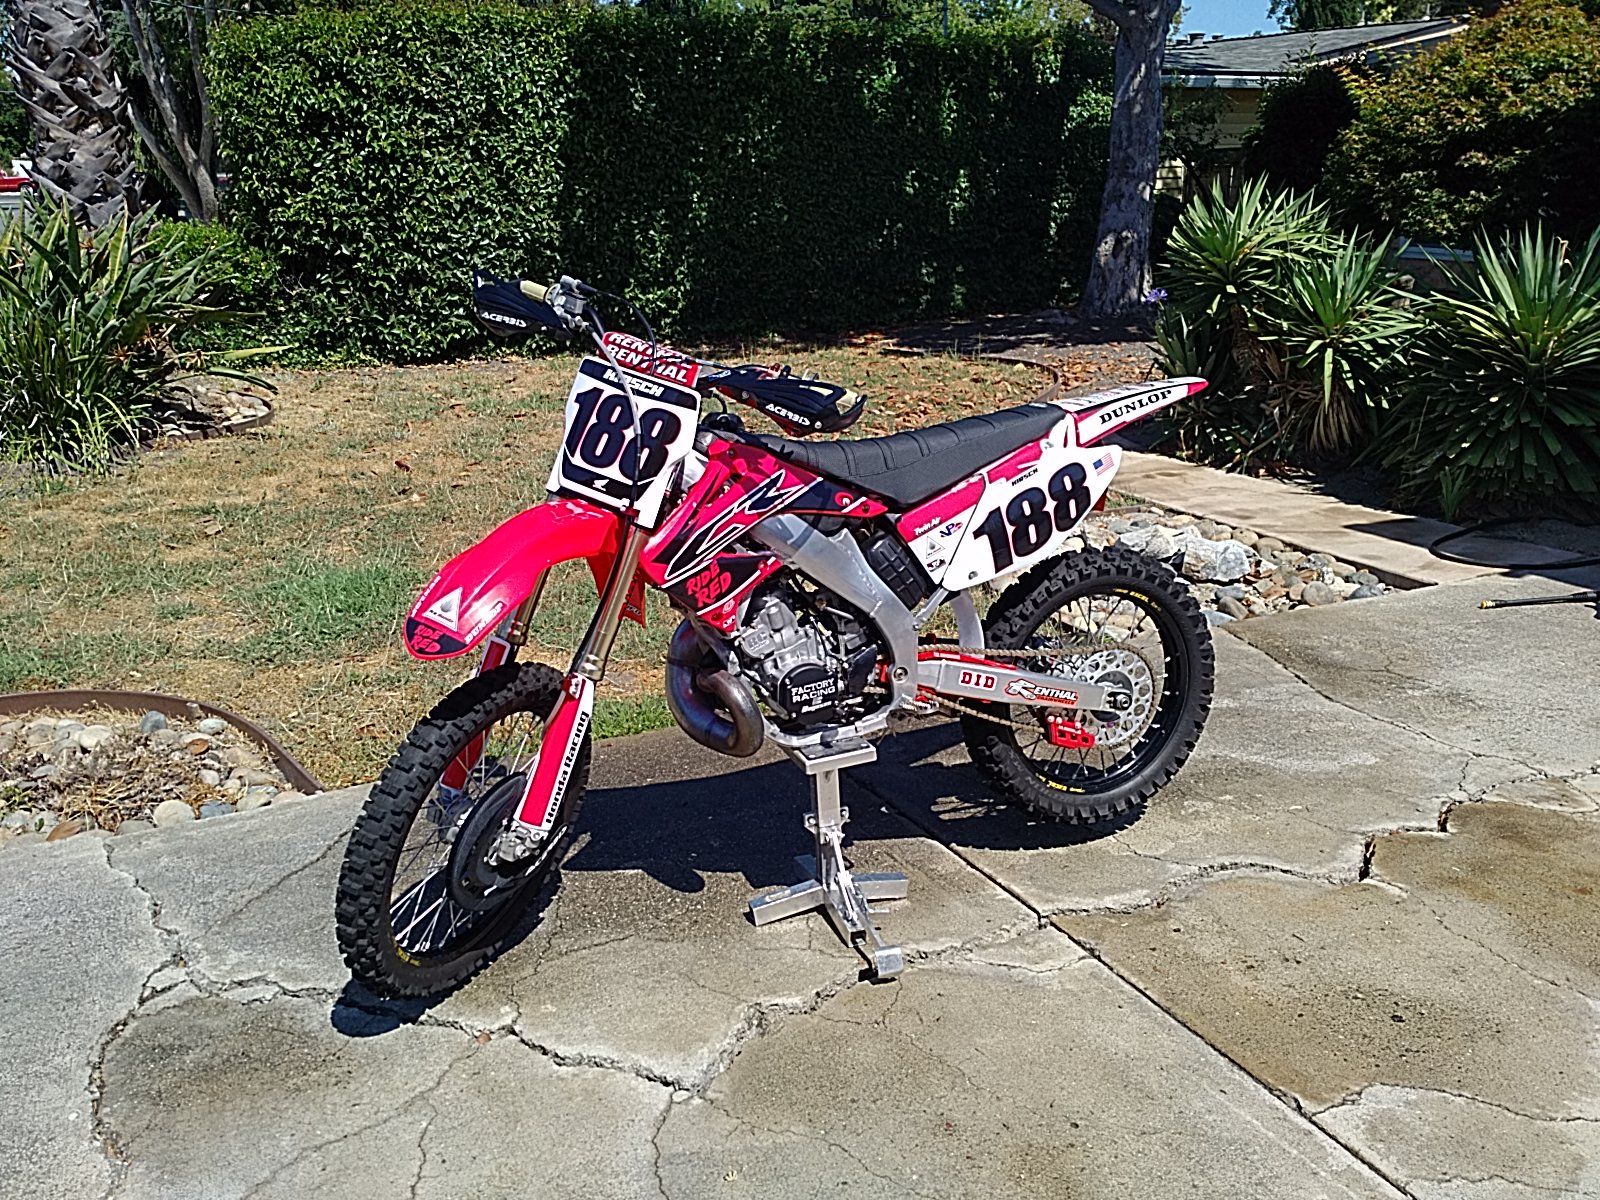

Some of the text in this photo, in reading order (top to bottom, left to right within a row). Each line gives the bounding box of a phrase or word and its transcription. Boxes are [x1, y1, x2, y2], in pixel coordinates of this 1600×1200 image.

[481, 311, 527, 328] ACERBIS
[602, 368, 665, 397] HRSCH
[765, 403, 811, 426] ACERBIS
[1099, 389, 1172, 425] DUNLOP
[565, 387, 681, 481] 188
[972, 462, 1091, 575] 188
[686, 558, 720, 596] RIDE
[695, 571, 731, 608] RED
[410, 635, 441, 653] RED
[791, 677, 835, 696] FACTORY
[792, 685, 836, 703] RACING
[960, 671, 996, 689] DID
[545, 769, 569, 824] Honda
[564, 710, 590, 768] Racing
